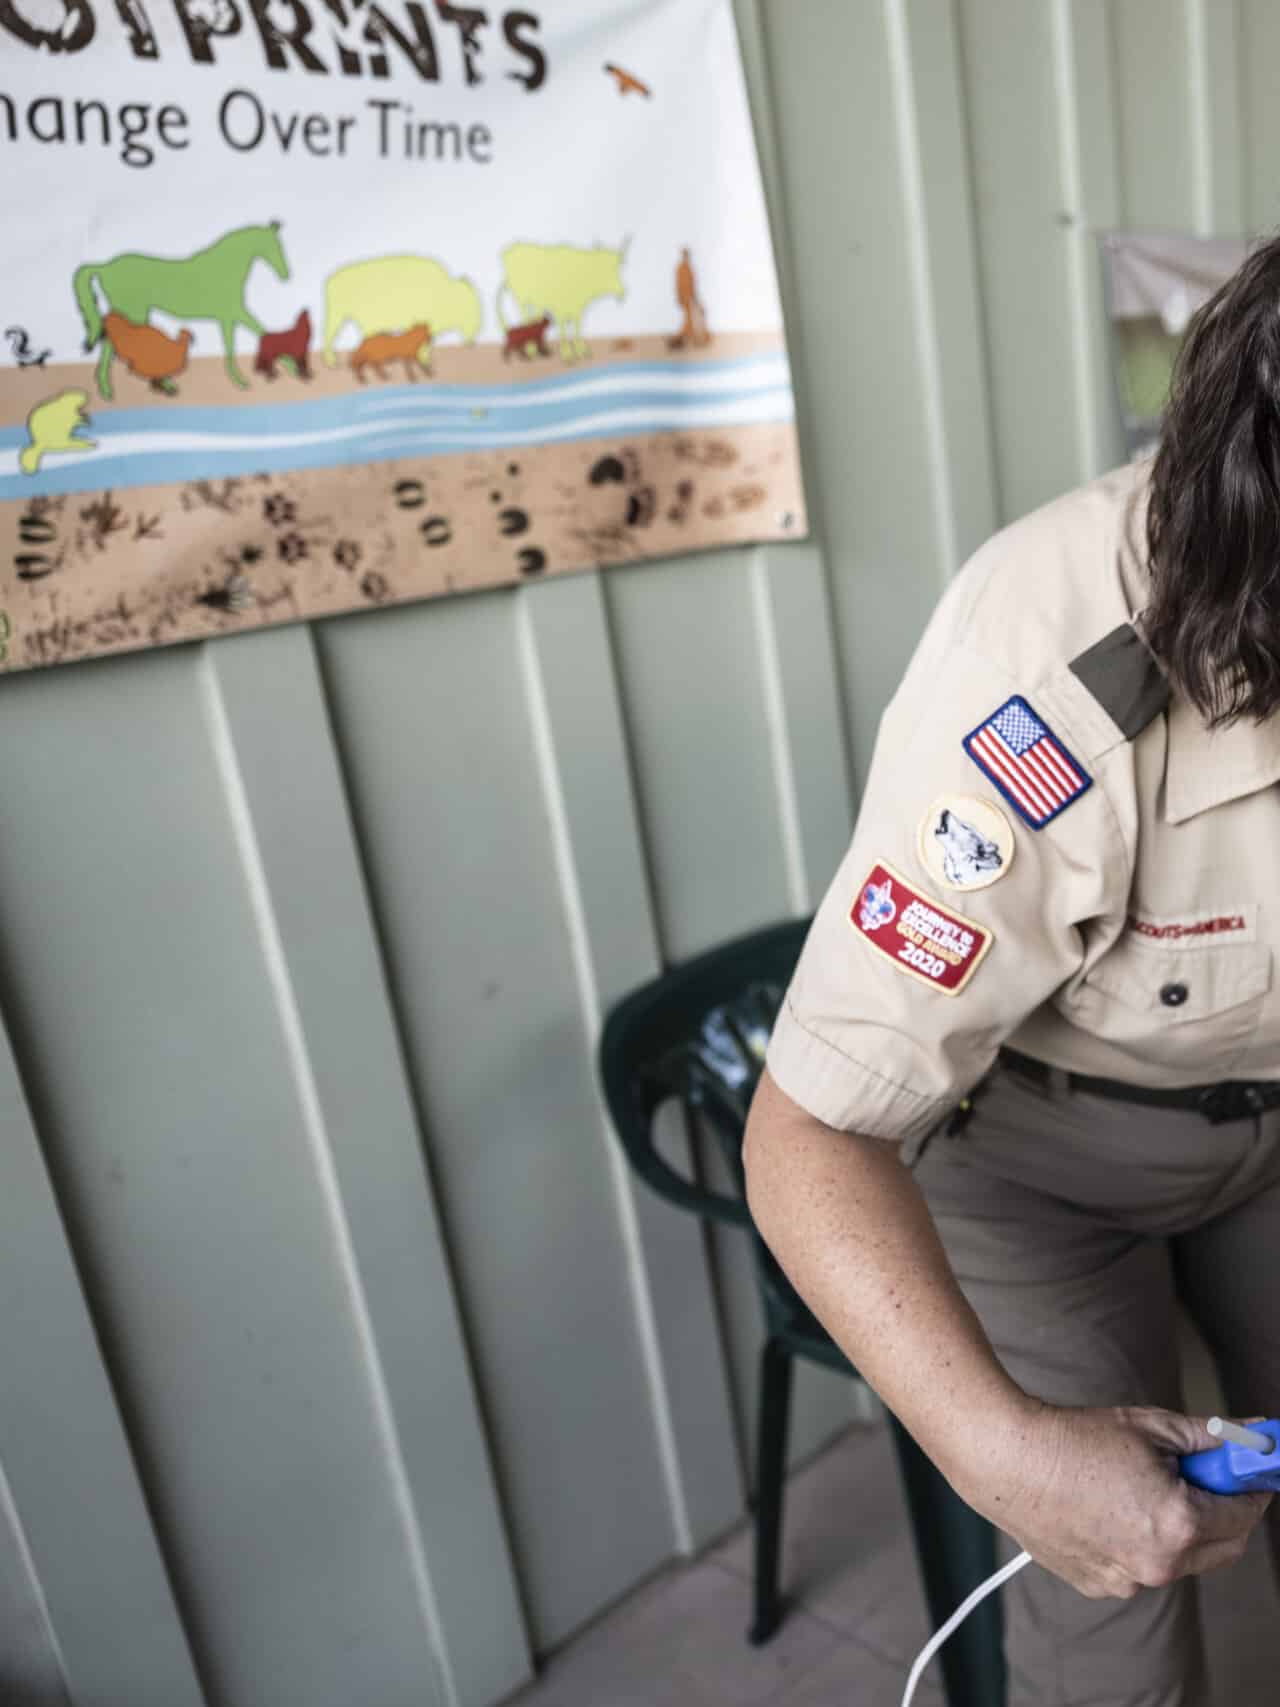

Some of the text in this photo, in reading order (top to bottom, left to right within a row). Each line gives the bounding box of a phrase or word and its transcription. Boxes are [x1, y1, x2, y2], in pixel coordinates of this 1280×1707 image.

[219, 89, 355, 156] Over
[367, 98, 492, 164] Time
[898, 942, 946, 977] 2020
